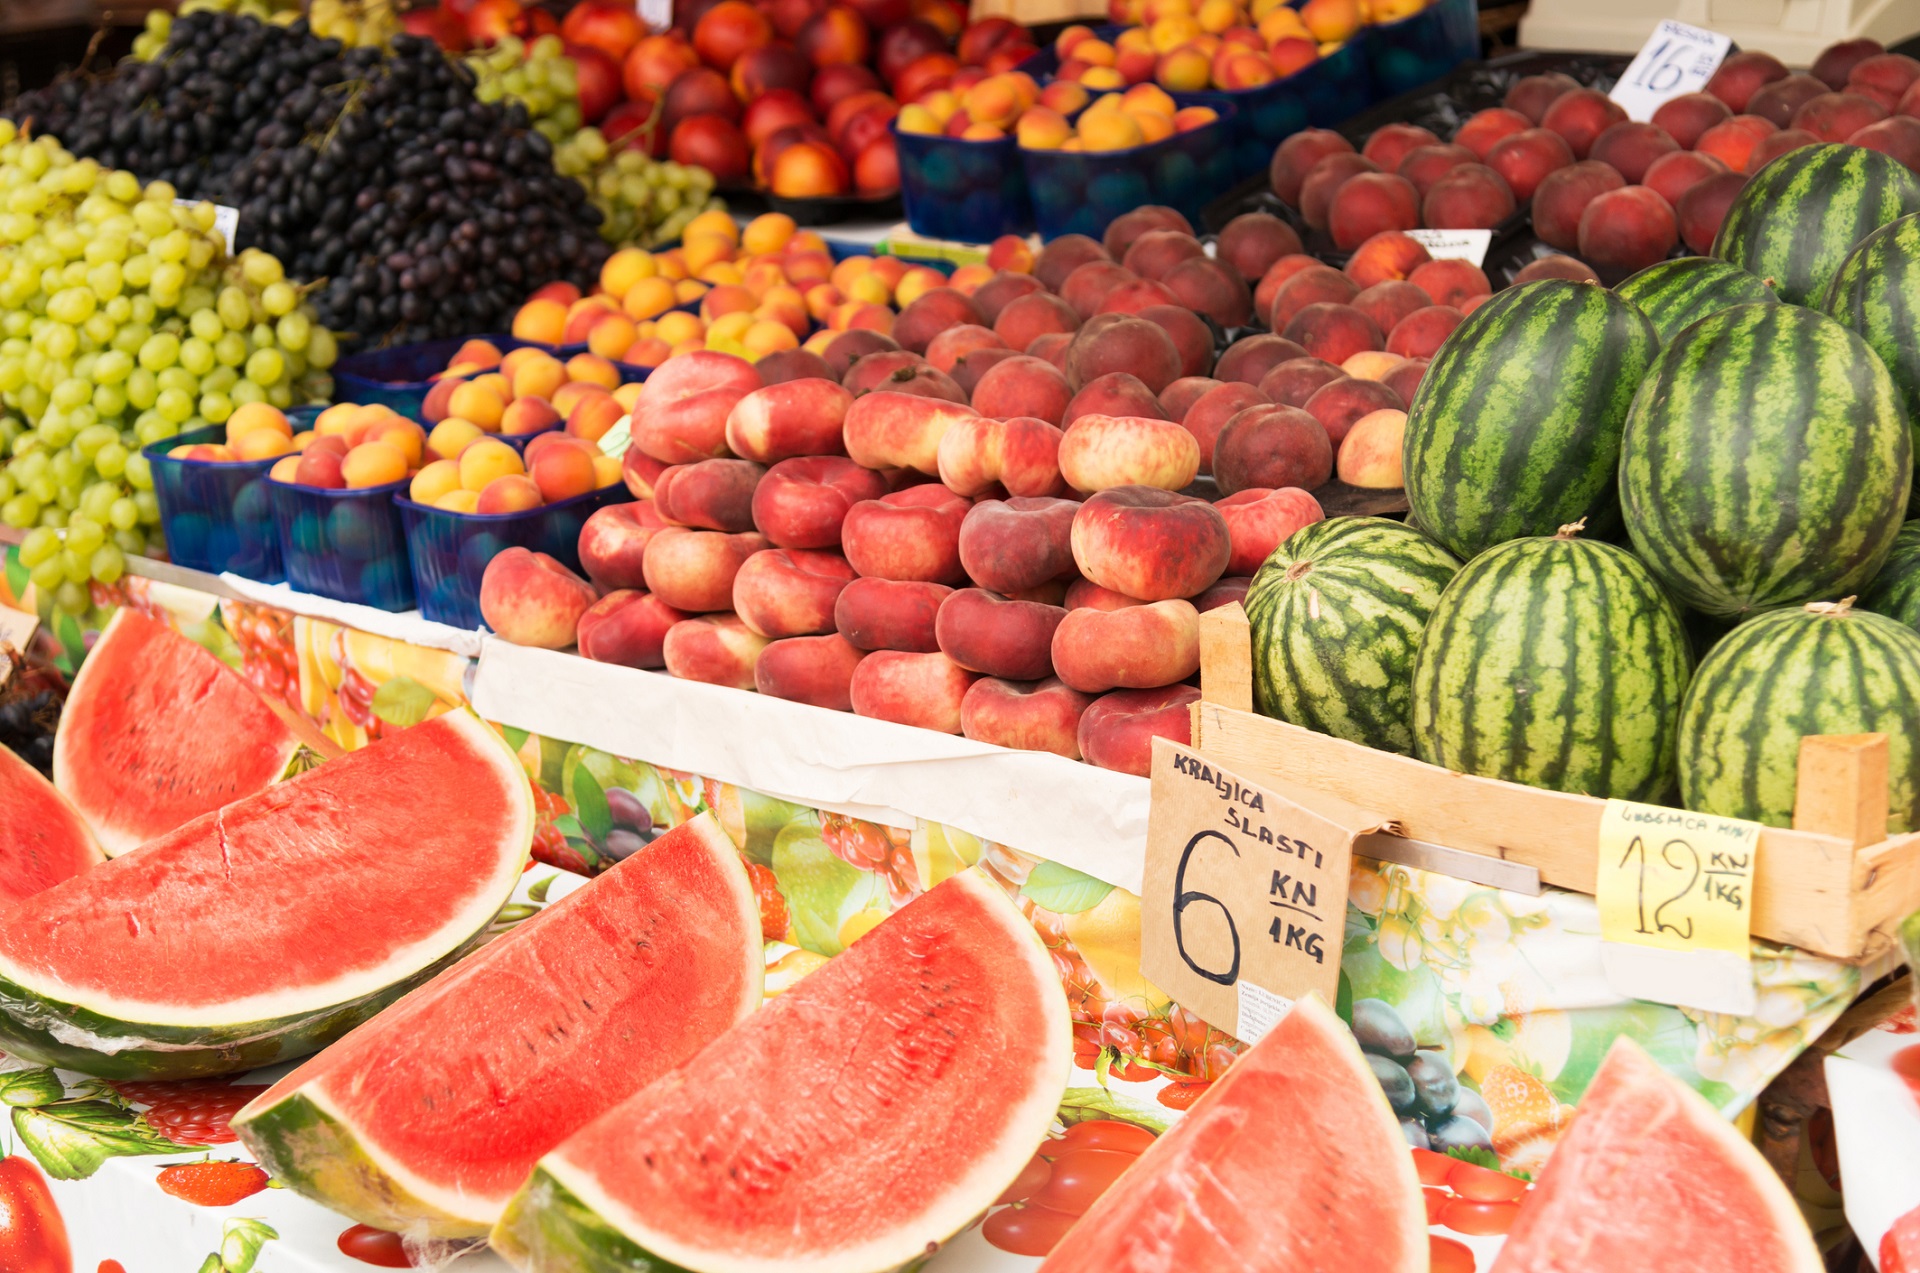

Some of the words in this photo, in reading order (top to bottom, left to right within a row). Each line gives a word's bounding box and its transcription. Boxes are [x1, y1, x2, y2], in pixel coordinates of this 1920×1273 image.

[1632, 39, 1694, 92] 16
[1224, 806, 1323, 869] SLASTI
[1711, 851, 1748, 869] KN
[1173, 829, 1241, 986] 6
[1269, 869, 1317, 907] KN
[1618, 835, 1700, 939] 12
[1704, 875, 1743, 911] 1KG
[1268, 916, 1325, 964] 1KG
